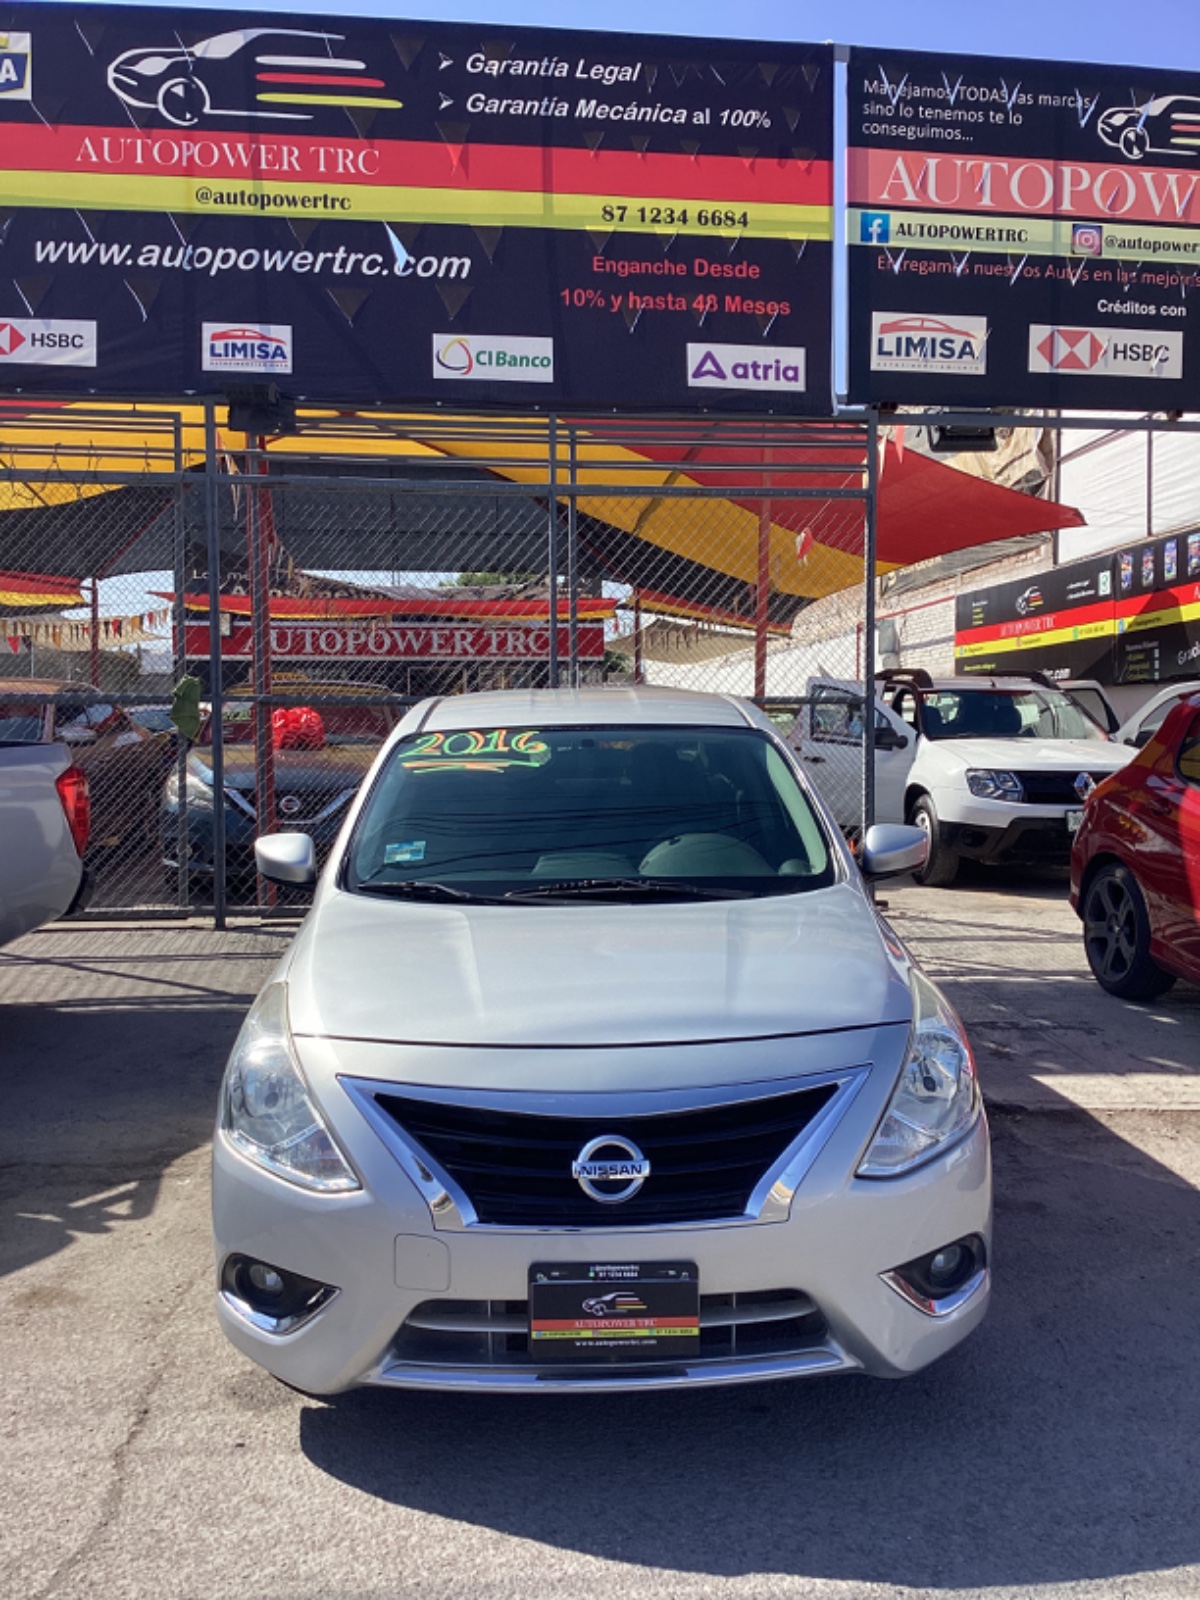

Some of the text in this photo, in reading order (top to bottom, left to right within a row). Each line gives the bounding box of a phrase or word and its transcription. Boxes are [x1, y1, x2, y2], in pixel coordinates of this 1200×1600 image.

[465, 53, 641, 85] Garantía Legal
[959, 85, 1008, 103] TODAS
[1012, 88, 1034, 105] as
[465, 94, 771, 128] Garantía Mecánica al 100%
[863, 101, 1022, 125] sino lo tenemos te lo
[862, 123, 973, 142] conseguimos...
[76, 137, 380, 175] AUTOPOWER TRC
[878, 155, 1200, 218] AUTOPOW
[195, 187, 351, 211] @autopowertrc
[601, 205, 749, 228] 87 1234 6684
[895, 222, 1028, 244] AUTOPOWERTRC
[34, 240, 471, 279] www.autopowertrc.com
[592, 256, 760, 279] Enganche Desde
[1093, 269, 1112, 282] en
[560, 288, 791, 315] 10% y hasta 48 Meses
[1097, 298, 1187, 317] Créditos con
[30, 331, 84, 349] HSBC
[210, 342, 287, 360] LIMISA
[877, 336, 975, 360] LIMISA
[1113, 342, 1170, 363] HSBC
[731, 359, 800, 383] atria
[243, 628, 551, 654] UTOPOWER TRC
[399, 729, 548, 756] 2016
[579, 1163, 642, 1176] NISSAN
